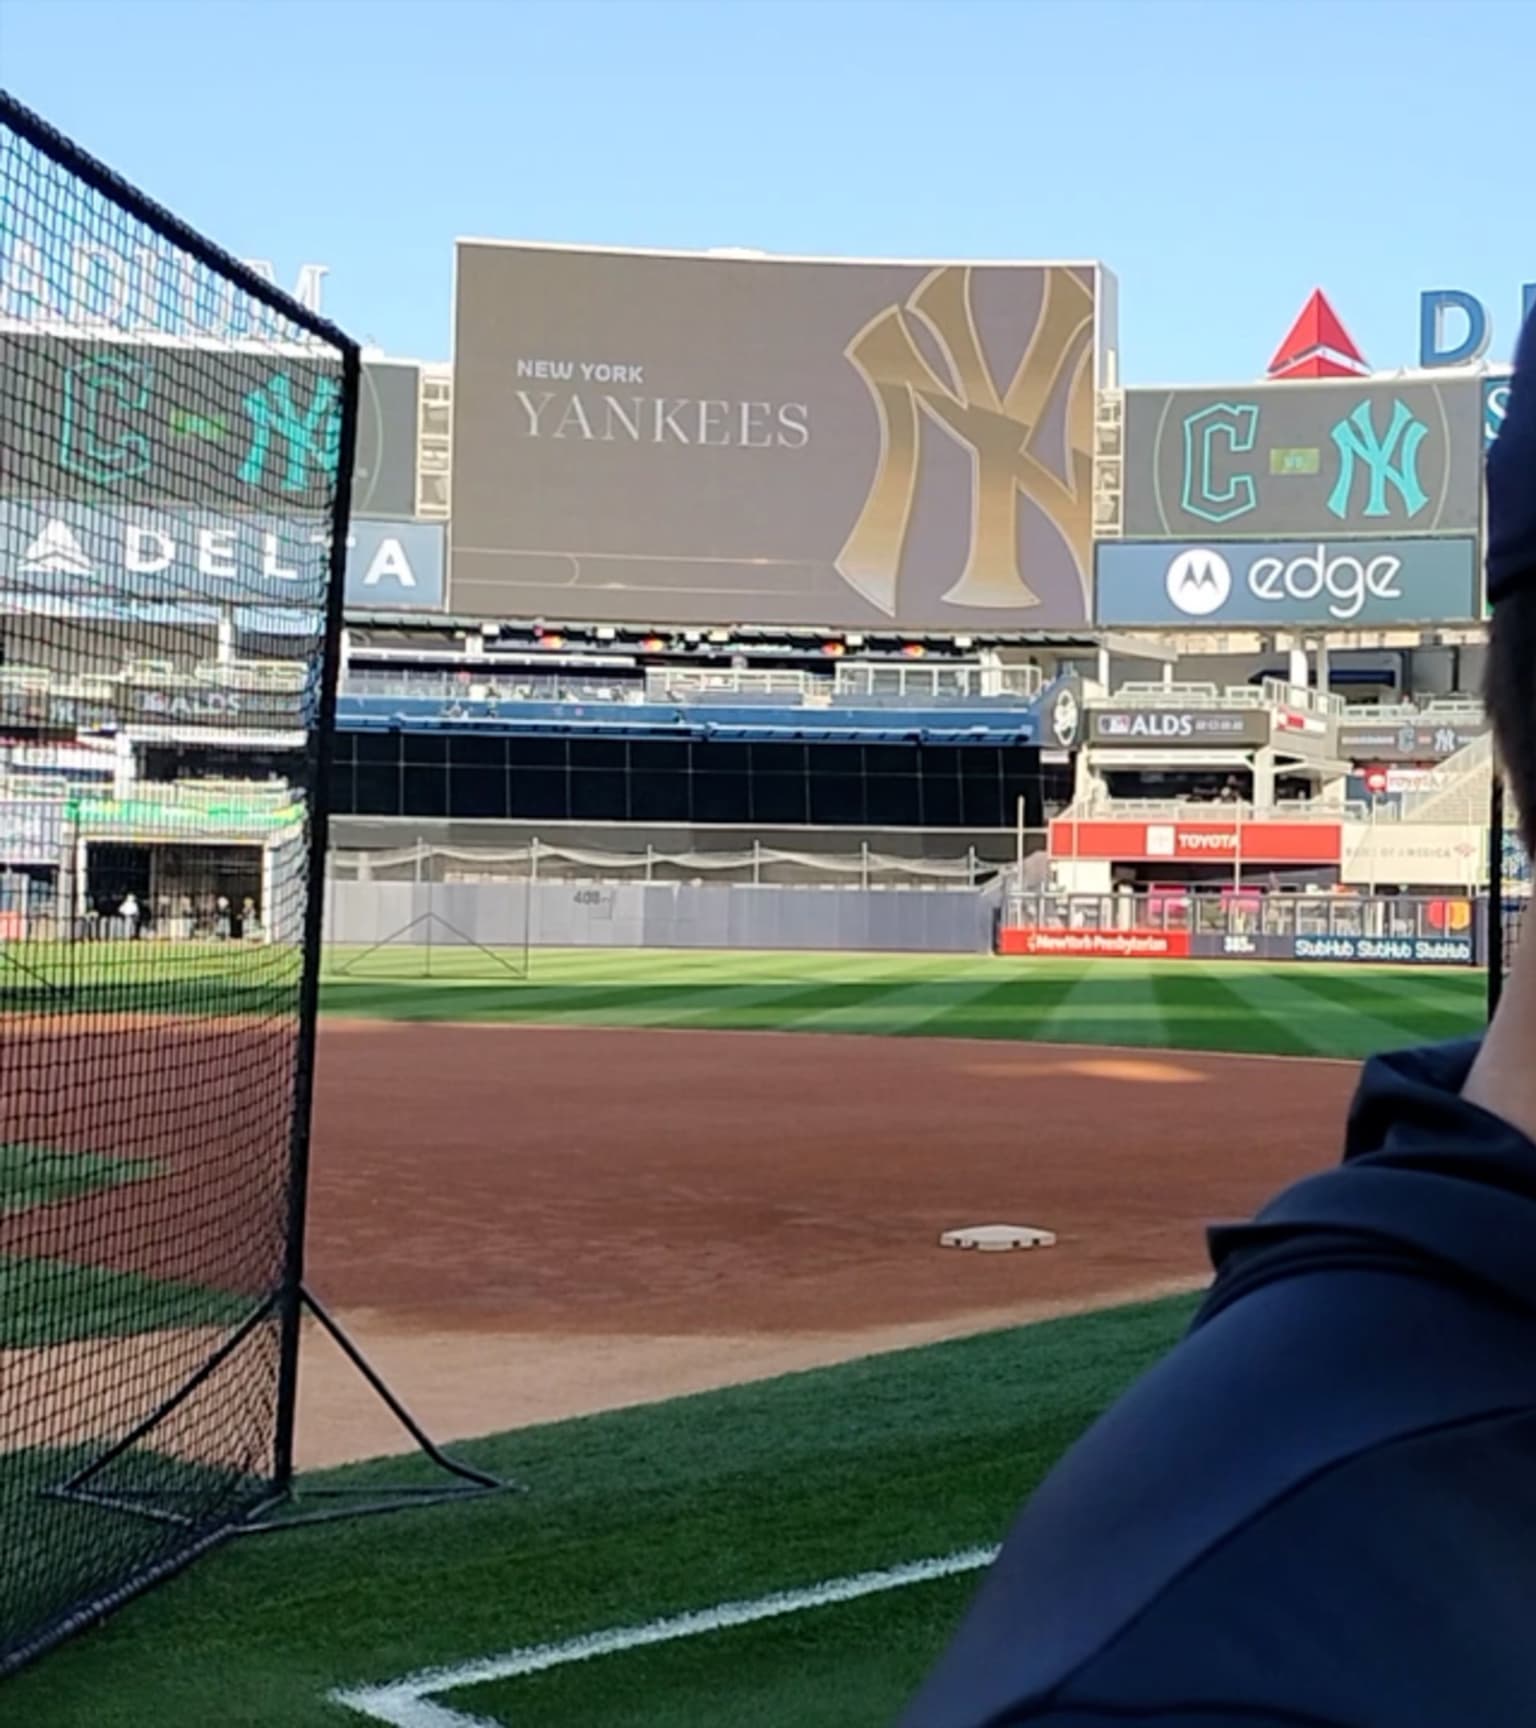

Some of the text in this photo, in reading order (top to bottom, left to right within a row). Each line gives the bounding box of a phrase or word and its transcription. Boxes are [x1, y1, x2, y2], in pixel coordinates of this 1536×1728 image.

[516, 360, 644, 383] NEW YORK
[515, 390, 810, 449] YANKEES
[1182, 402, 1258, 522] C
[1327, 399, 1430, 519] NY
[1248, 544, 1402, 618] edge
[1130, 714, 1193, 735] ALDS
[1179, 833, 1239, 849] TOYOTA
